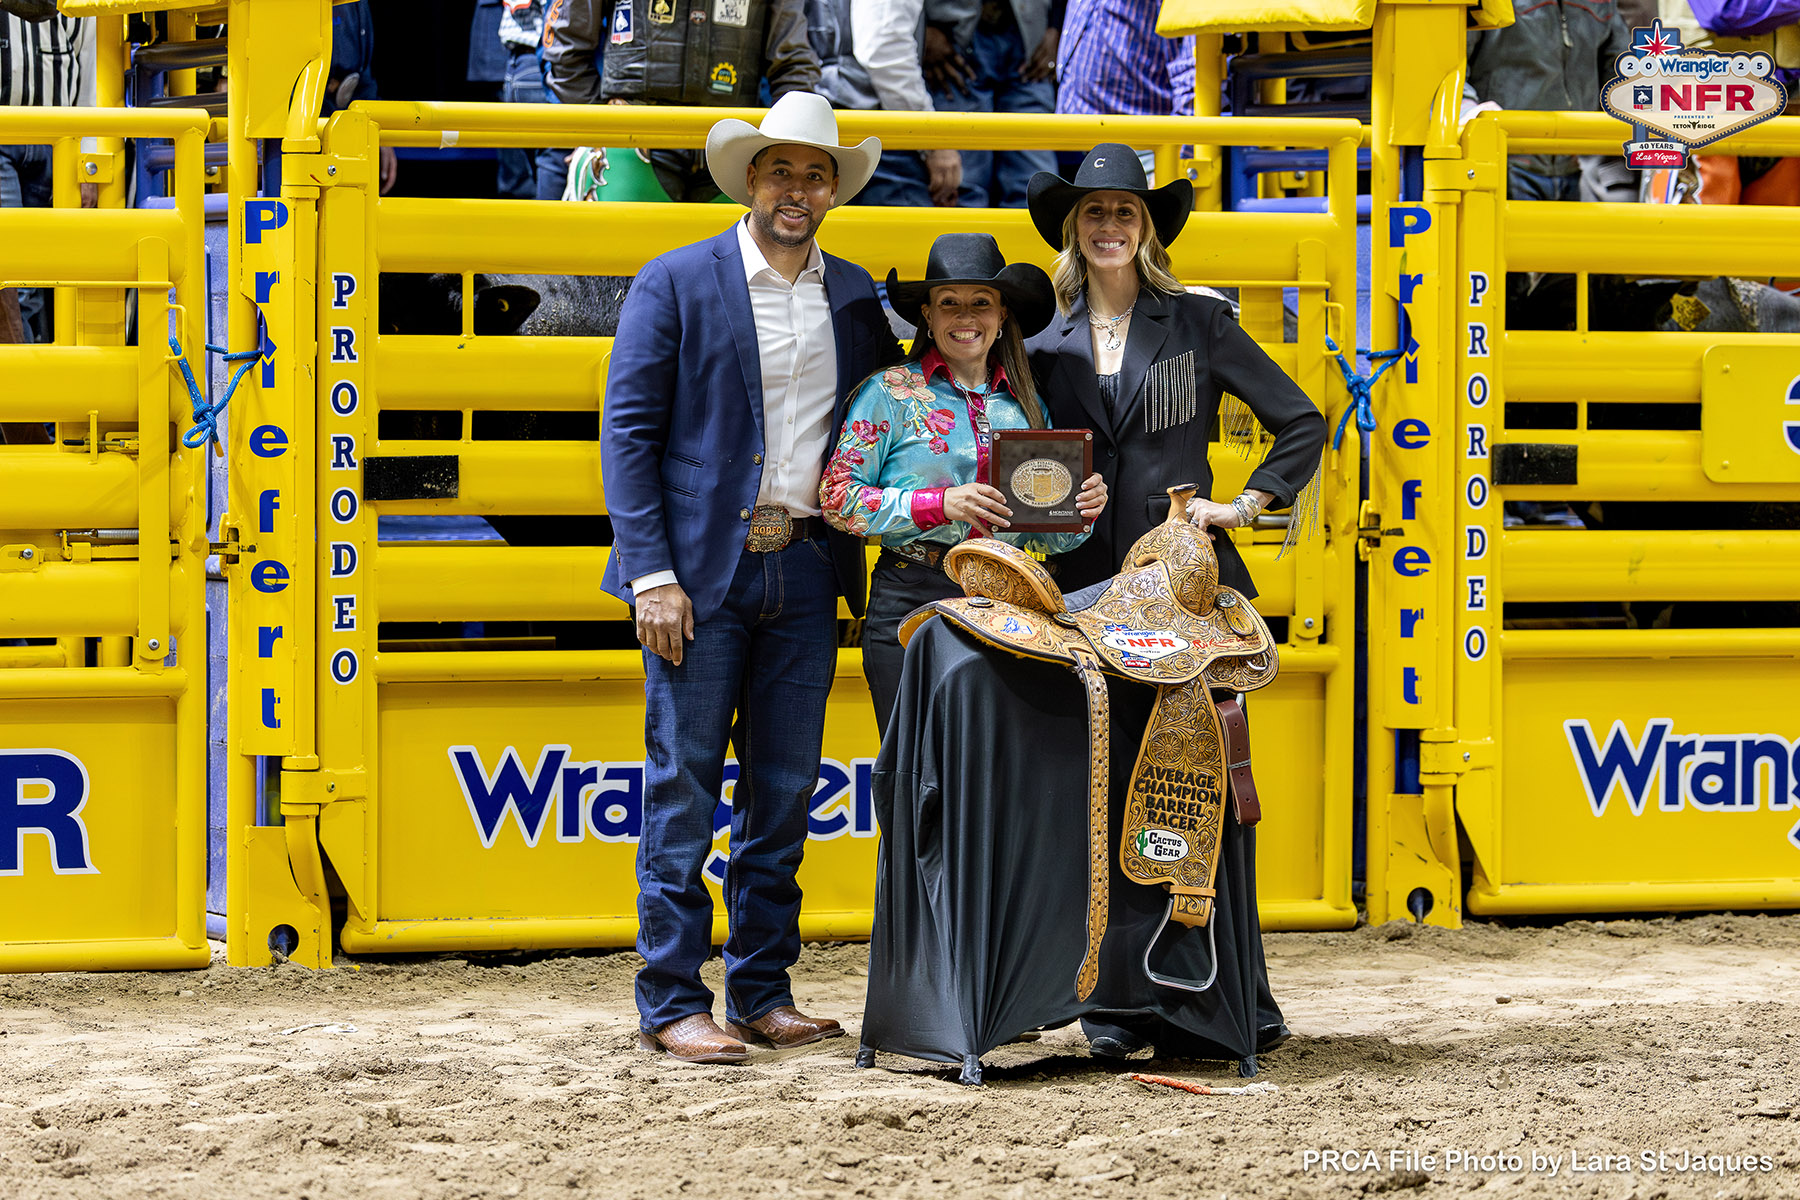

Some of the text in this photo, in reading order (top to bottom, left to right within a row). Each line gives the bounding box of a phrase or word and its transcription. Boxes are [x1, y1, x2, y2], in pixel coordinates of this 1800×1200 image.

[1464, 270, 1490, 661] PRORODEO
[329, 272, 359, 686] PRORODEO
[753, 526, 782, 535] RODEO
[1127, 638, 1176, 647] NFR
[1142, 765, 1217, 789] AVERAGE
[1563, 718, 1800, 849] Wran
[1134, 779, 1221, 805] CHAMPION
[1145, 795, 1204, 818] BARREL
[1147, 809, 1198, 831] RACER
[1154, 845, 1180, 858] GEAR
